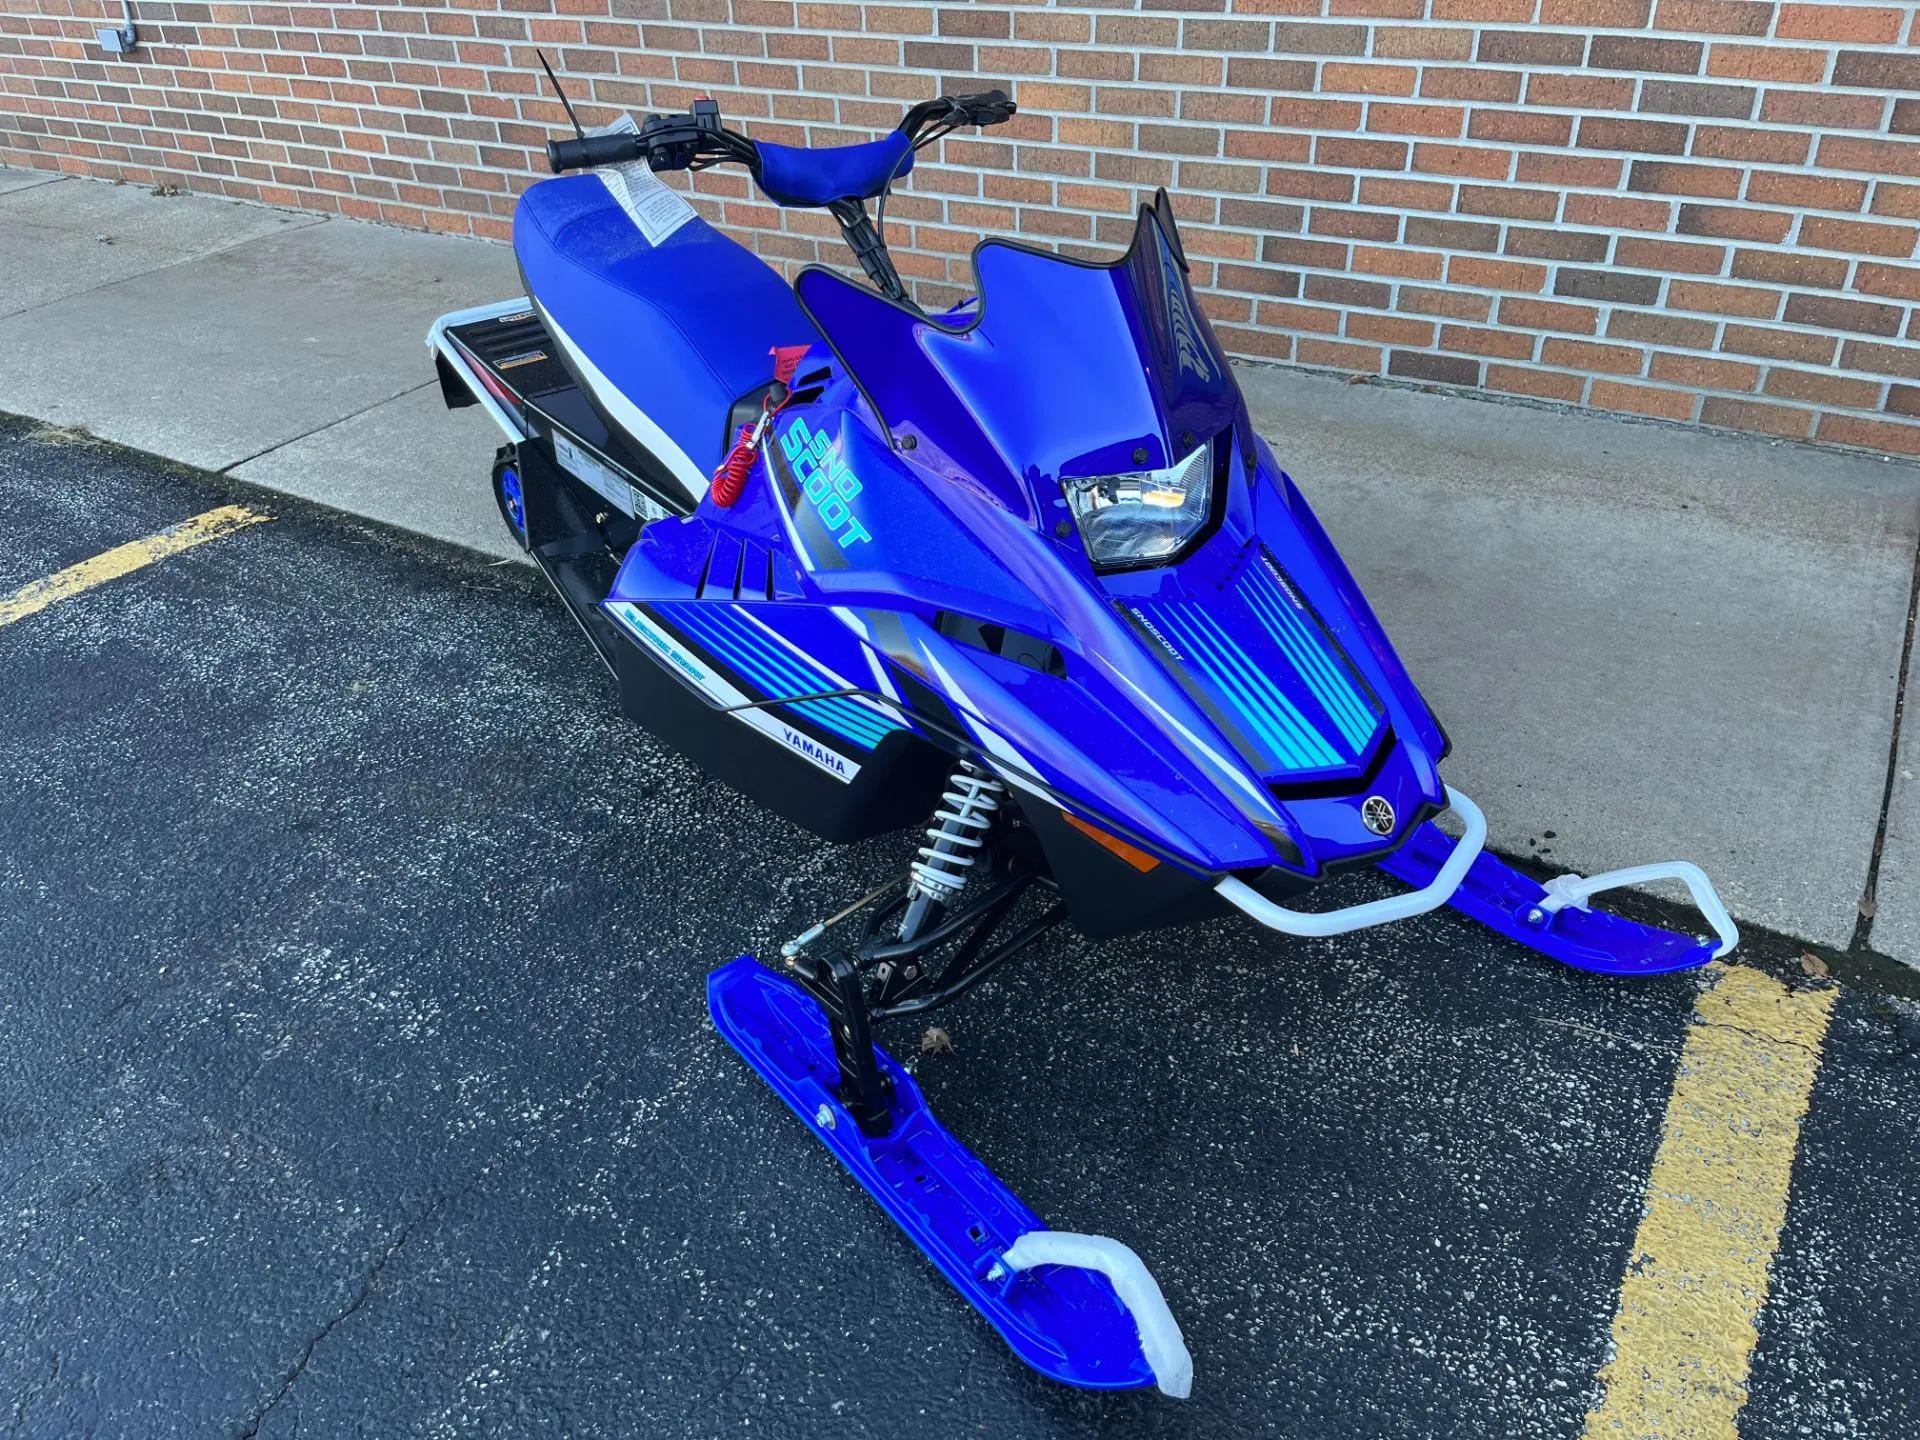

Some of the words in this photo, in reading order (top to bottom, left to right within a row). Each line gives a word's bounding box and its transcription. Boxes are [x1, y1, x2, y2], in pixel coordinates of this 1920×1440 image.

[780, 416, 872, 548] SCOOT
[808, 429, 863, 502] SNO
[1260, 555, 1304, 610] SNOSCOOT
[1130, 607, 1185, 661] SNOSCOOT
[783, 728, 845, 774] YAMAHA
